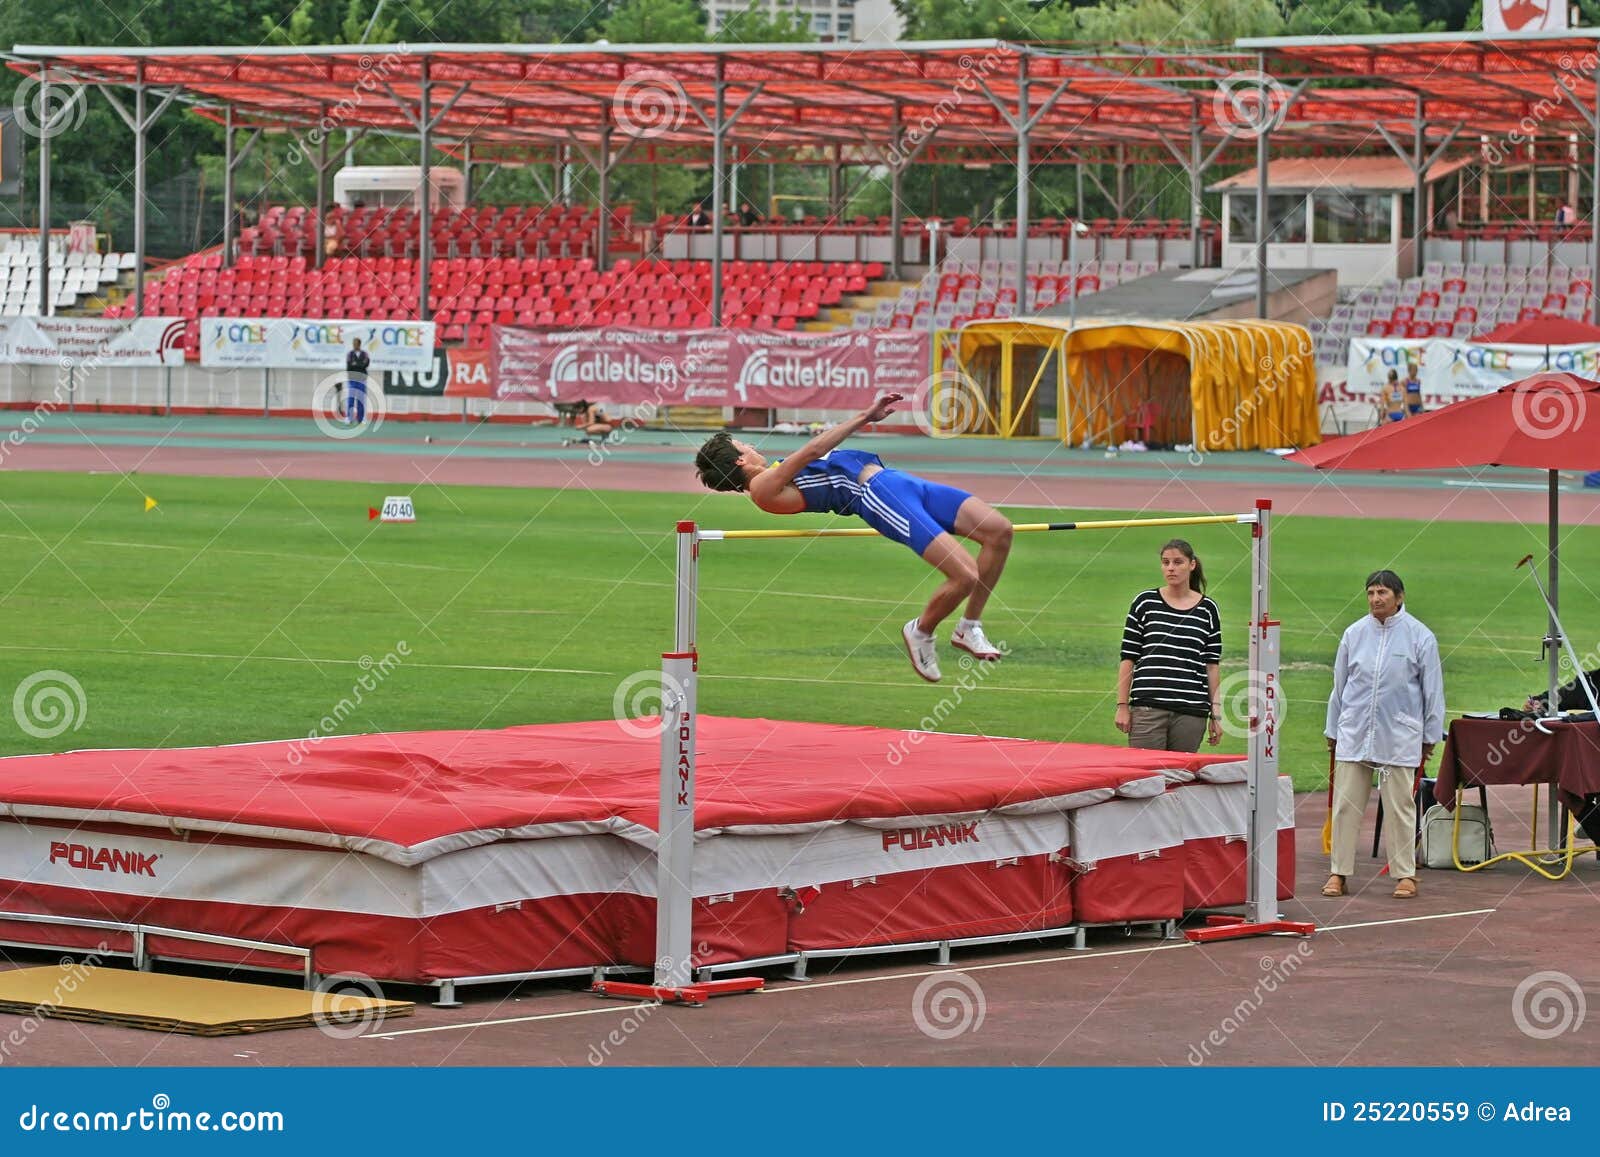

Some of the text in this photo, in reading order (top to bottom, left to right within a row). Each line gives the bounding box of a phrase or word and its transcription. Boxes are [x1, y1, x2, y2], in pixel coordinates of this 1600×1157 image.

[580, 353, 678, 383] atletism
[769, 358, 869, 388] atletism
[384, 503, 413, 517] 40 40
[1264, 673, 1277, 758] POLANIK
[678, 712, 690, 806] POLANIK
[882, 820, 980, 853] POLANIK
[50, 841, 159, 878] POLANIK
